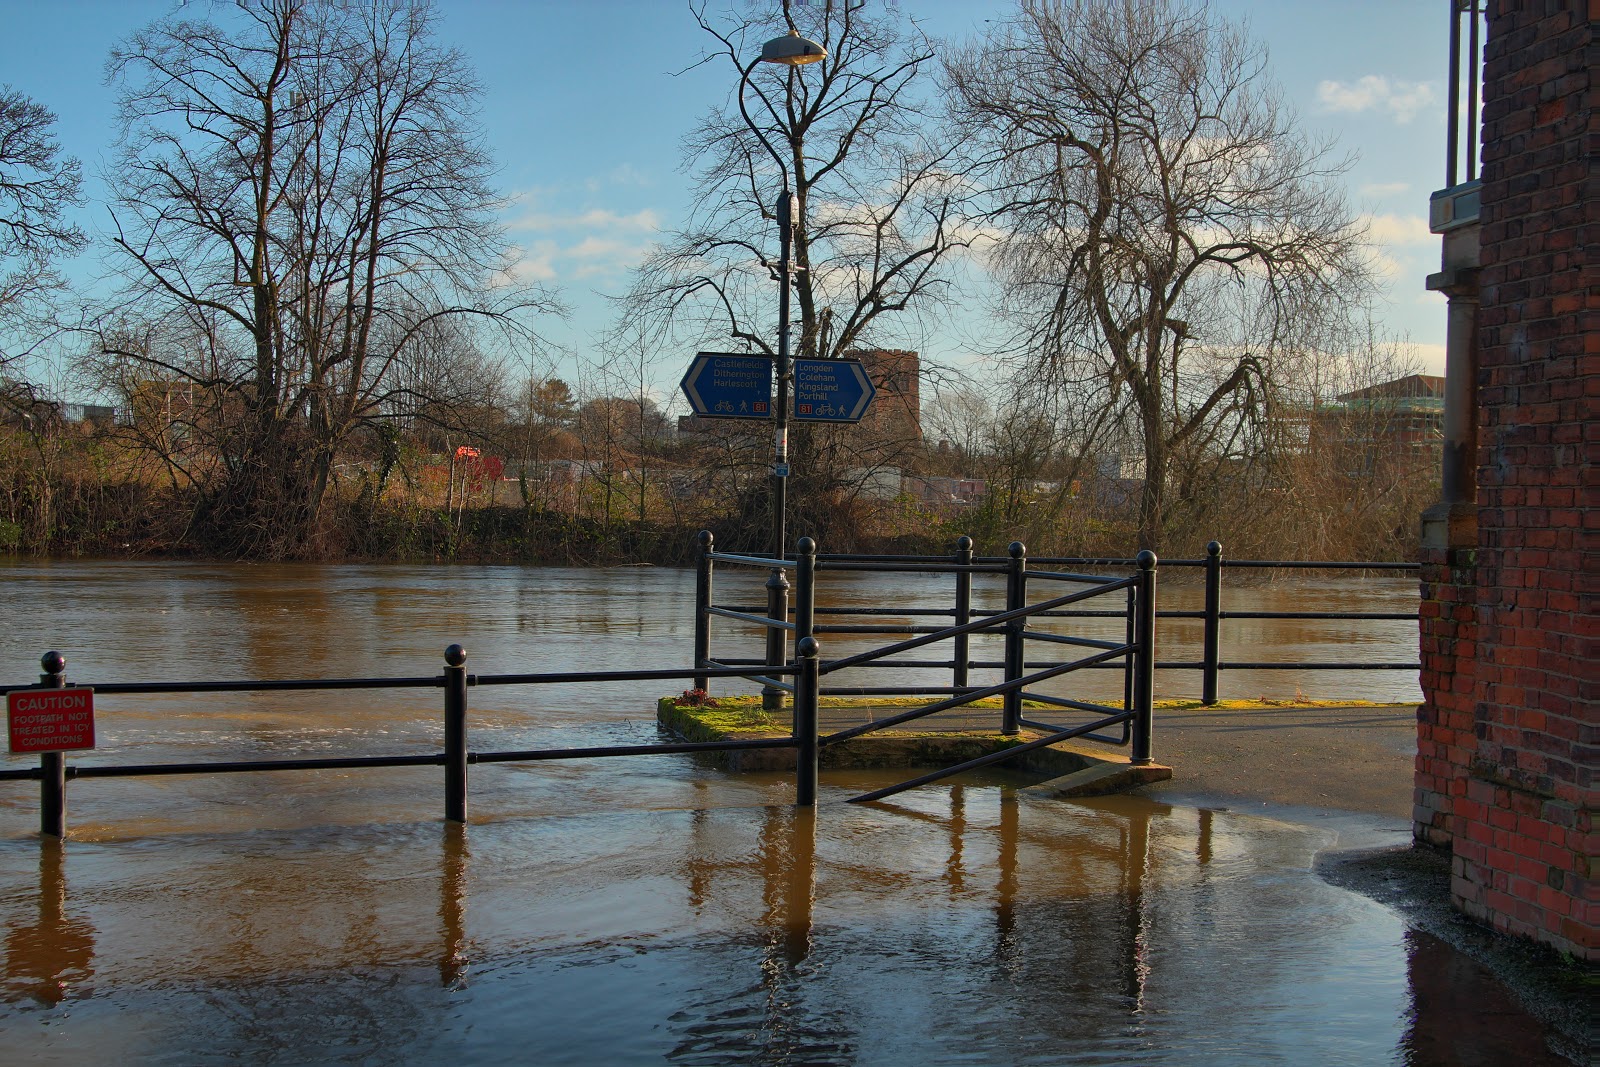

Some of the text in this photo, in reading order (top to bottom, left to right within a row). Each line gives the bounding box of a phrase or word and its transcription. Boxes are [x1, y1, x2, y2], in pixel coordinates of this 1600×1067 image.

[714, 359, 764, 369] Castlefields
[799, 363, 833, 372] Longden
[714, 369, 765, 379] Ditherington
[799, 372, 836, 382] Coleham
[714, 379, 758, 388] Harlescott
[798, 382, 838, 392] Kingsland
[798, 392, 828, 400] Porthill
[756, 403, 766, 412] 81
[800, 405, 811, 413] 81
[16, 696, 86, 711] CAUTION
[14, 712, 88, 724] FOOTPATH NOT
[13, 724, 90, 735] TREATED IN ICY
[22, 734, 83, 746] CONDITIONS
